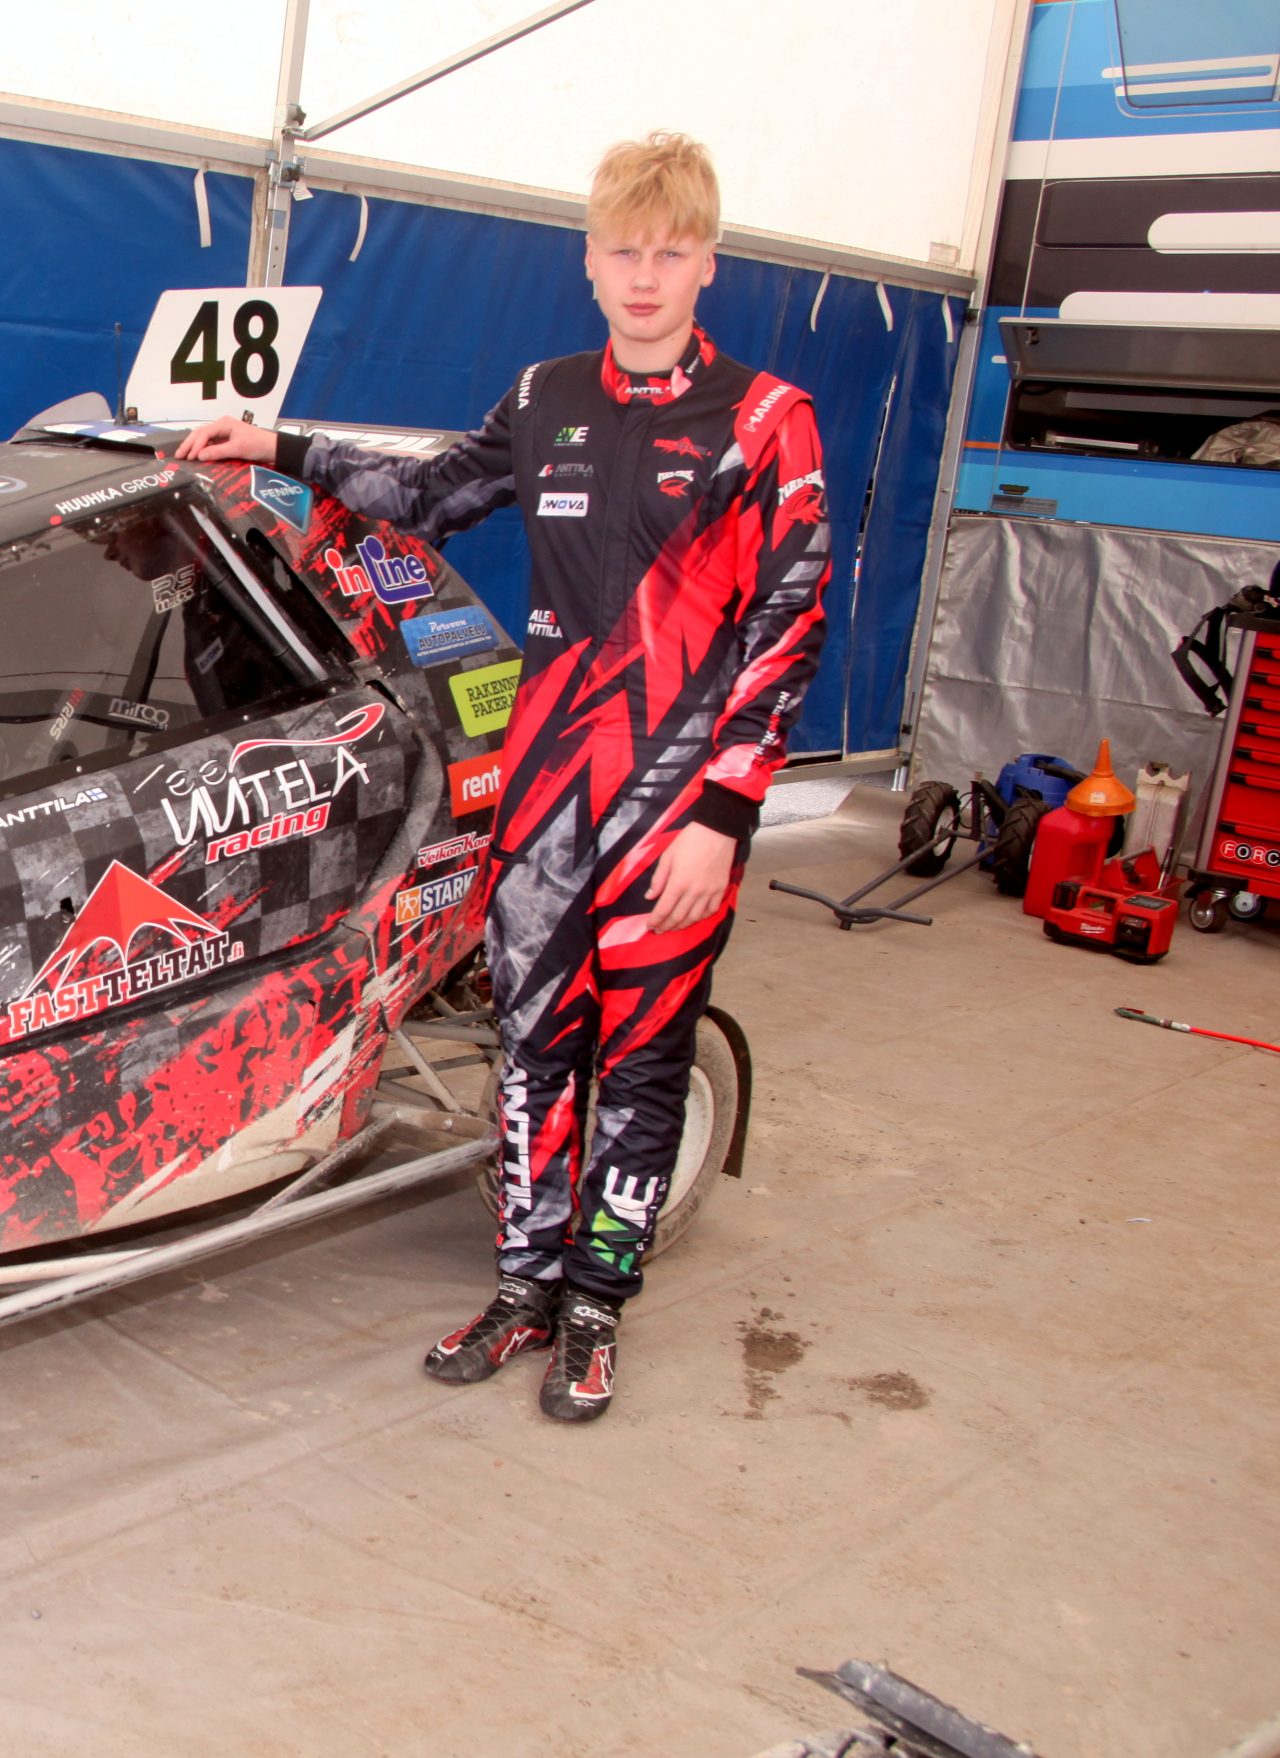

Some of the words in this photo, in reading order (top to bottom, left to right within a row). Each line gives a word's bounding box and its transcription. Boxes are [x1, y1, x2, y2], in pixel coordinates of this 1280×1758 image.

[170, 300, 279, 400] 48
[56, 485, 122, 516] HUUHKA
[120, 469, 177, 495] GROUP
[259, 485, 304, 499] FENNO
[418, 622, 488, 651] AUTOPALVELU
[204, 801, 332, 866] racing
[421, 870, 475, 913] STARK
